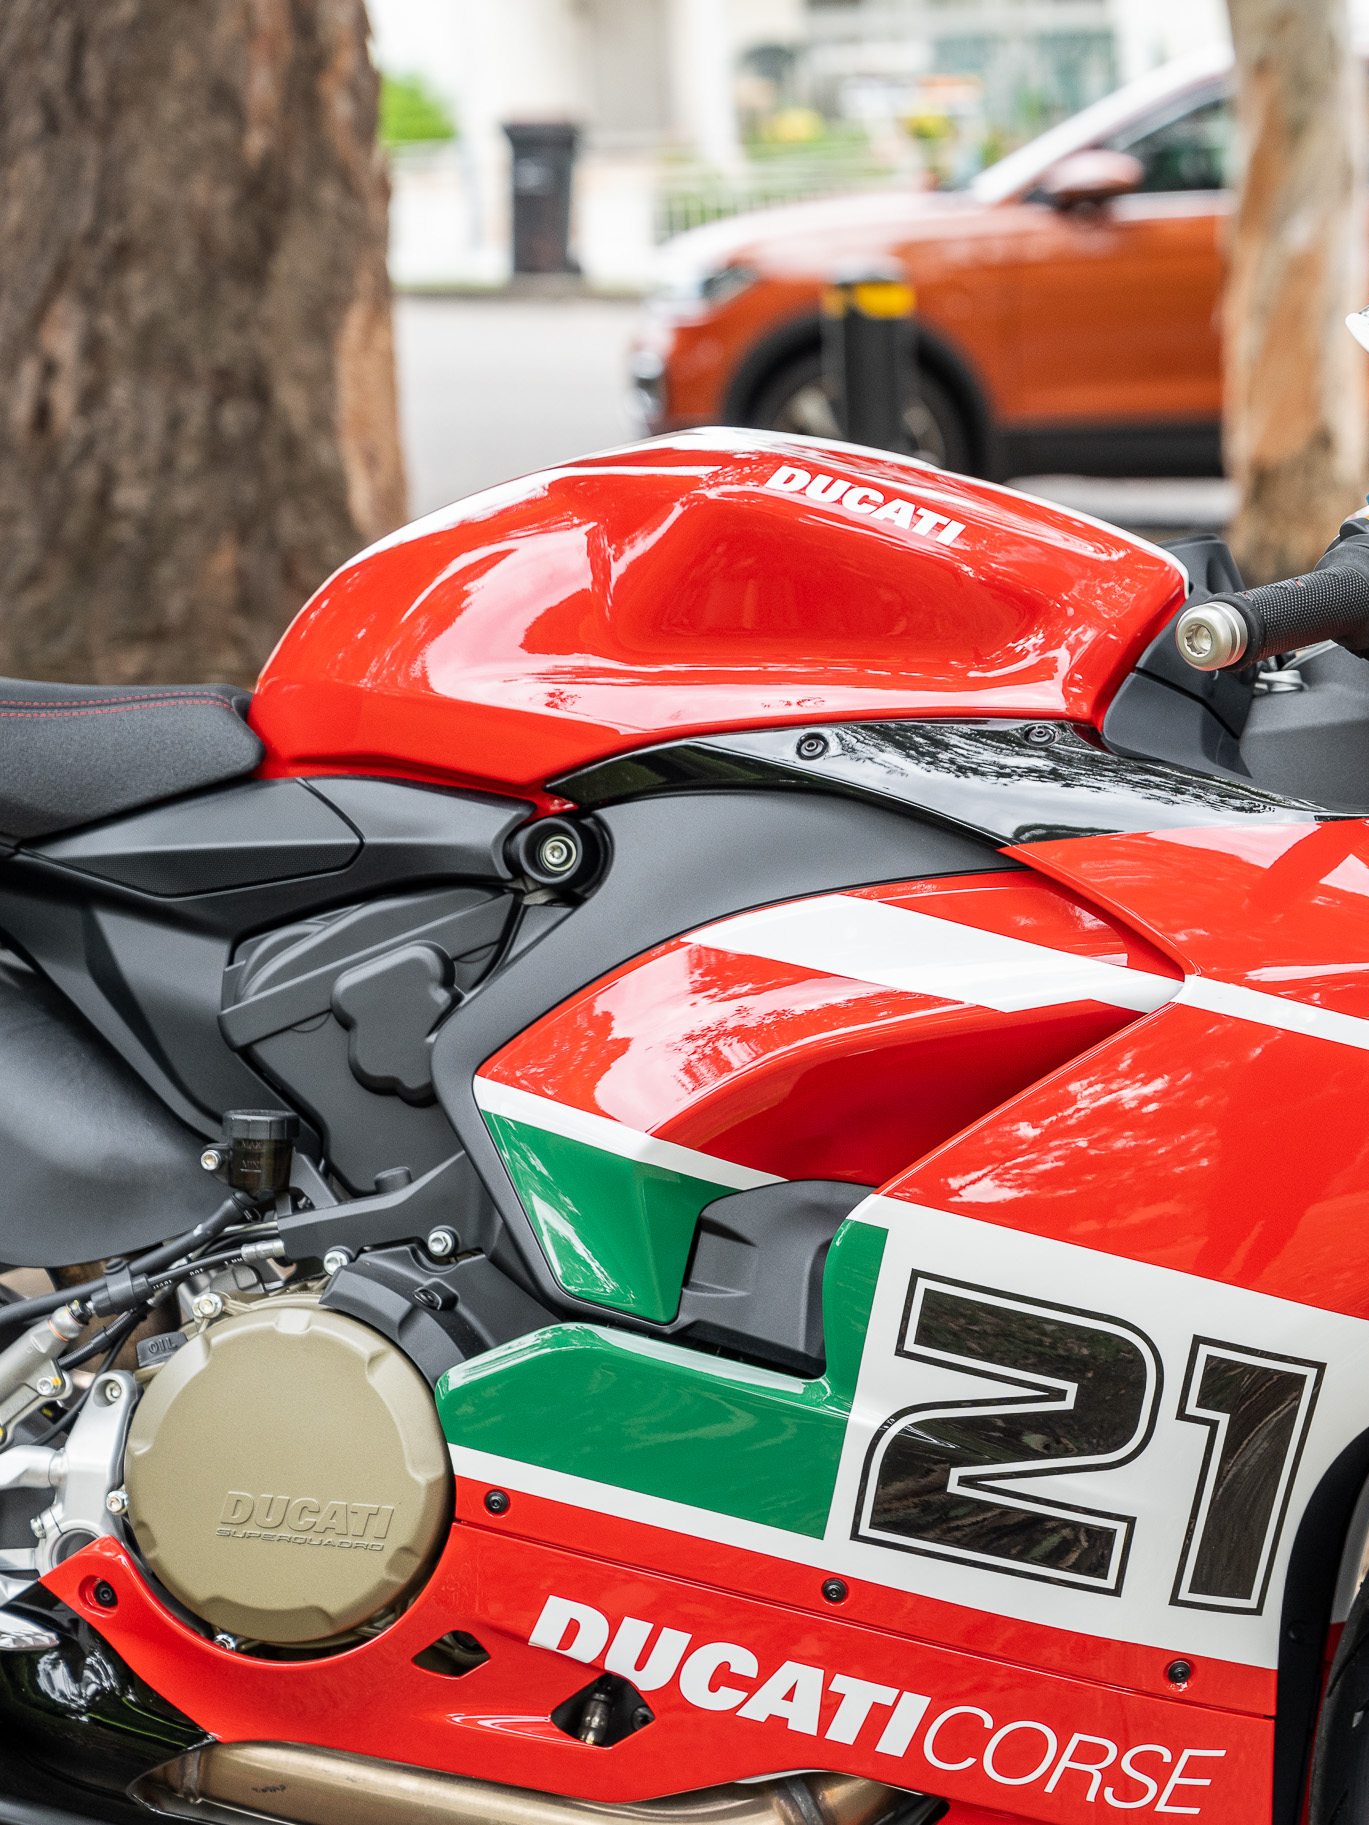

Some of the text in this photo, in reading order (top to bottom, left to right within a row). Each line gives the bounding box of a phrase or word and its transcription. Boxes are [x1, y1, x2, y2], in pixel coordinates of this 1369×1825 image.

[764, 465, 966, 546] DUCATI
[148, 1337, 178, 1355] OIL
[850, 1268, 1328, 1616] 21
[220, 1490, 395, 1539] DUCATI
